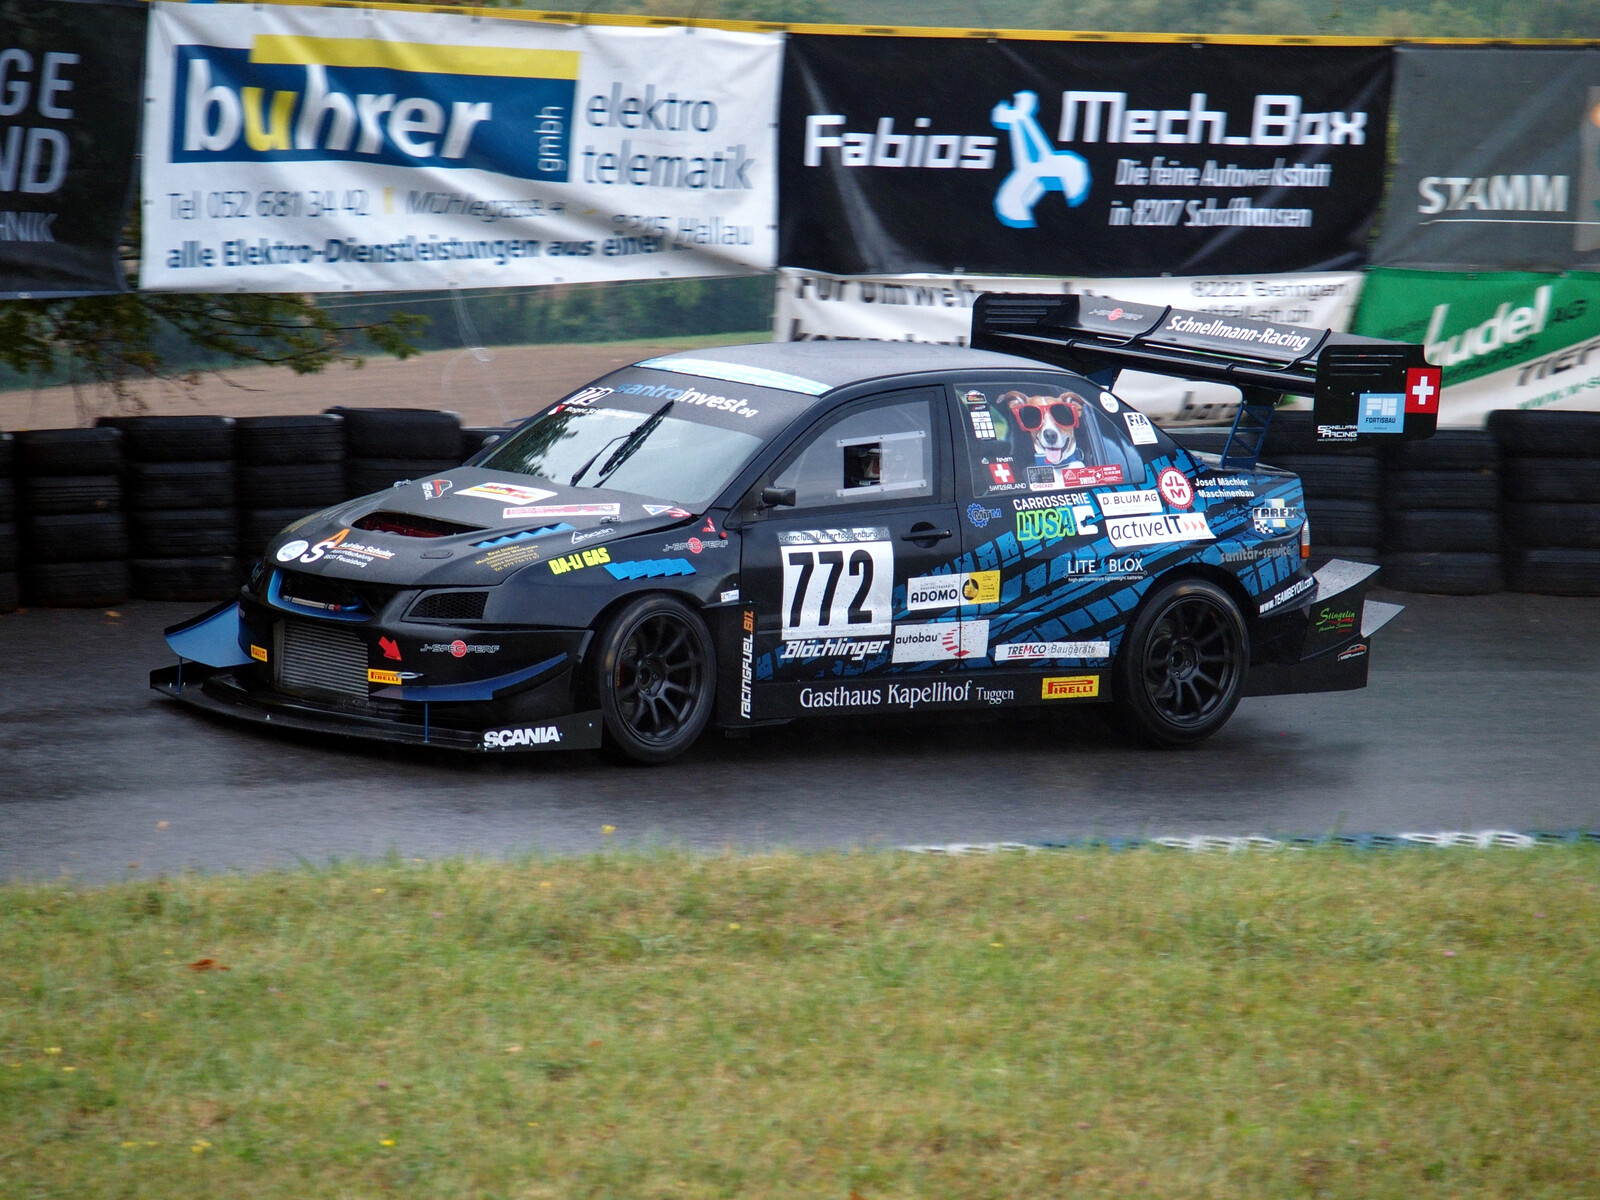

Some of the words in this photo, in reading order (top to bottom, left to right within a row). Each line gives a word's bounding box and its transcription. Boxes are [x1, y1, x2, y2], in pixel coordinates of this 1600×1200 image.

[183, 58, 493, 160] buhrer
[586, 82, 719, 133] elektro
[533, 105, 567, 173] gmbh
[804, 114, 998, 170] Fabios
[581, 139, 754, 190] telematik
[1114, 158, 1149, 186] Die
[1149, 156, 1200, 187] feine
[167, 190, 197, 220] Tel
[207, 190, 252, 218] 052
[341, 188, 371, 217] 42
[1418, 174, 1570, 214] STAMM
[1108, 200, 1132, 227] in
[1131, 199, 1185, 227] 8207
[1183, 196, 1312, 228] Schaffhausen
[676, 215, 754, 246] Hallau
[166, 240, 217, 269] alle
[547, 239, 596, 258] aus
[1165, 314, 1311, 350] Schnellmann-Racing
[1365, 416, 1397, 424] FORTISBAU
[1194, 477, 1217, 488] Josef
[1218, 476, 1249, 487] Mächler
[1197, 486, 1256, 499] Maschinenbau
[1013, 492, 1091, 512] CARROSSERIE
[1114, 494, 1141, 505] BLUM
[1144, 492, 1158, 502] AG
[1015, 507, 1077, 542] LUSA
[1110, 515, 1183, 541] activeIT
[582, 546, 612, 567] GAS
[1067, 559, 1097, 575] LITE
[1108, 558, 1144, 574] BLOX
[788, 548, 874, 628] 772
[910, 588, 958, 604] ADOMO
[780, 637, 891, 661] Blöchlinger
[895, 633, 938, 646] autobau
[1007, 644, 1047, 656] TREMCO
[370, 670, 400, 683] PIRELLI
[1047, 679, 1094, 695] PIRELLI
[799, 686, 882, 709] Gasthaus
[887, 680, 972, 709] Kapellhof
[975, 685, 1015, 705] Tuggen
[483, 725, 562, 748] SCANIA
